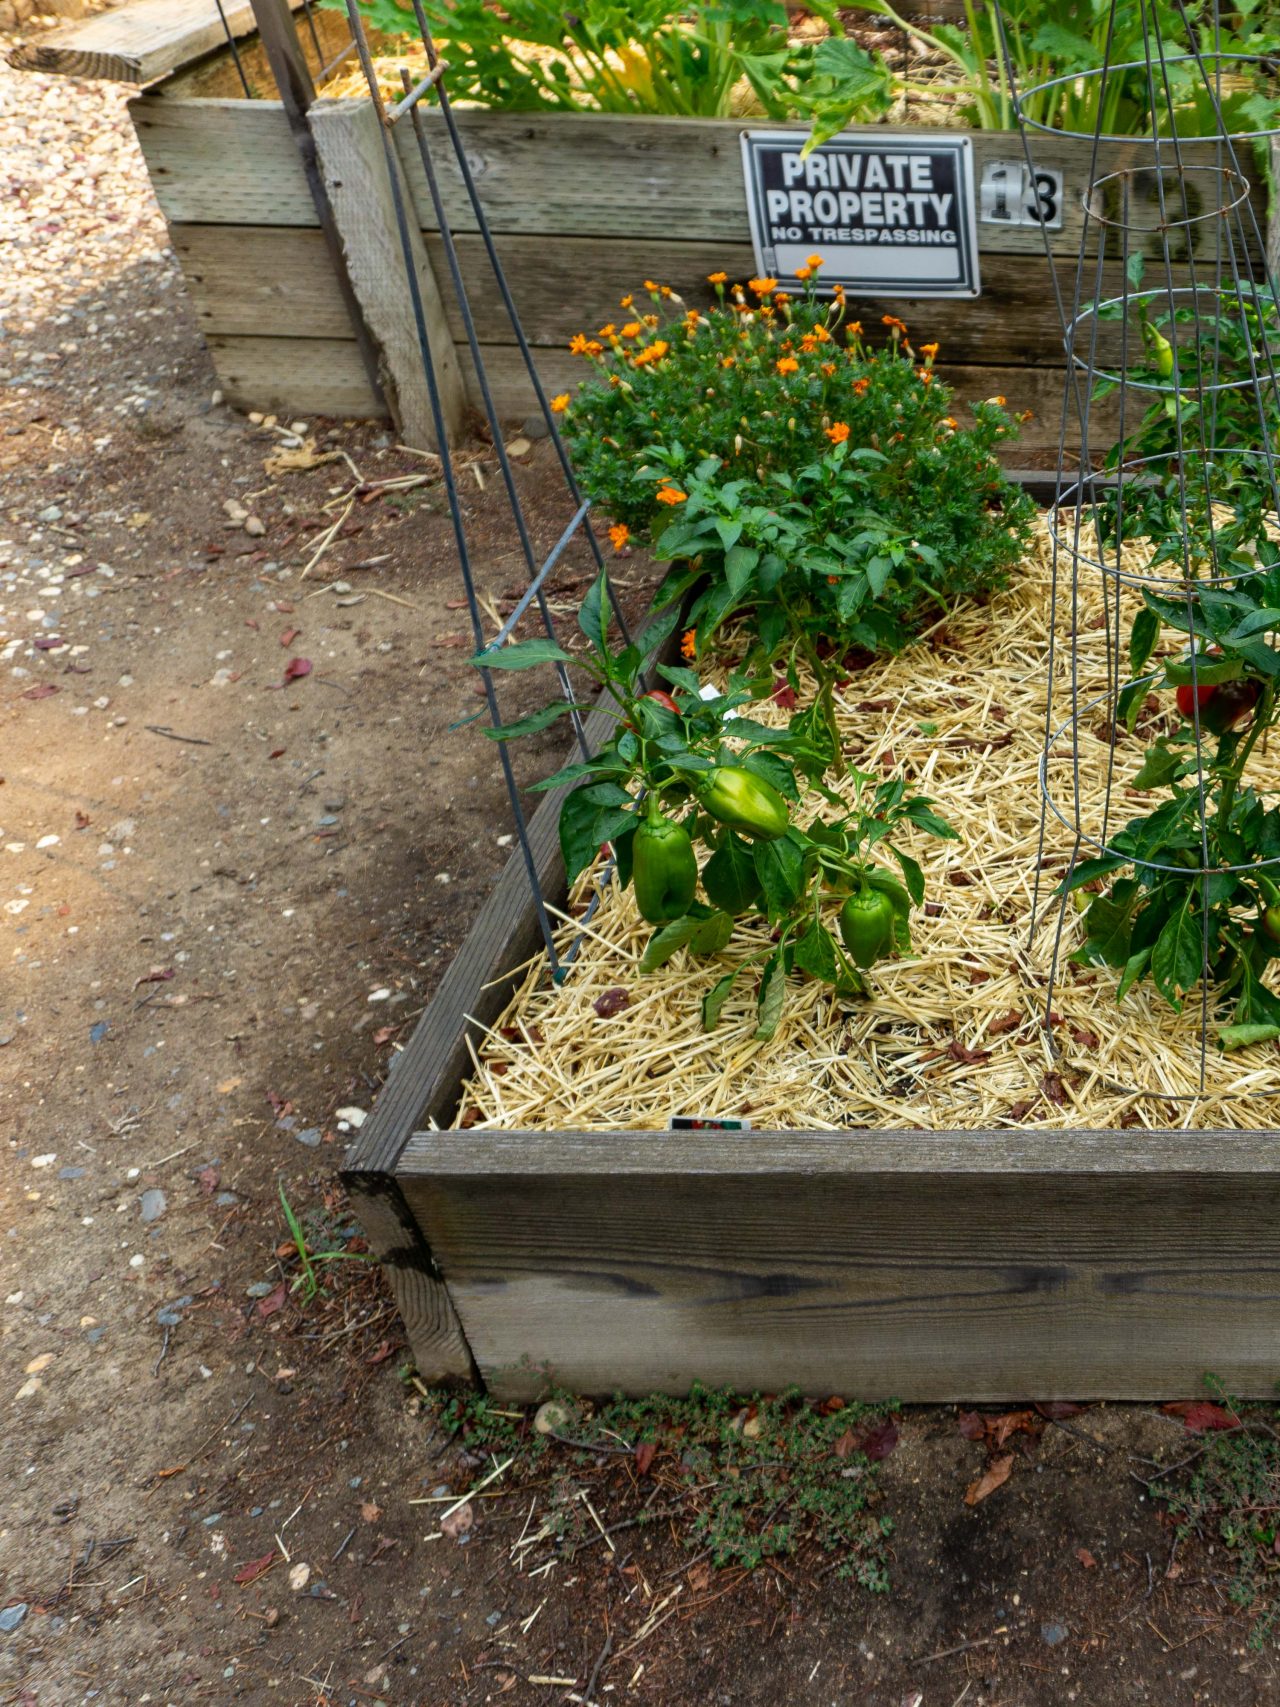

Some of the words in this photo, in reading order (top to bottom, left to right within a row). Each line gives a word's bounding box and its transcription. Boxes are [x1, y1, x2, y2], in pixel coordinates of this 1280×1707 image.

[781, 152, 934, 189] PRIVATE
[766, 190, 953, 226] PROPERTY
[989, 168, 1058, 223] 13
[771, 226, 803, 241] NO
[808, 227, 957, 244] TRESPASSING
